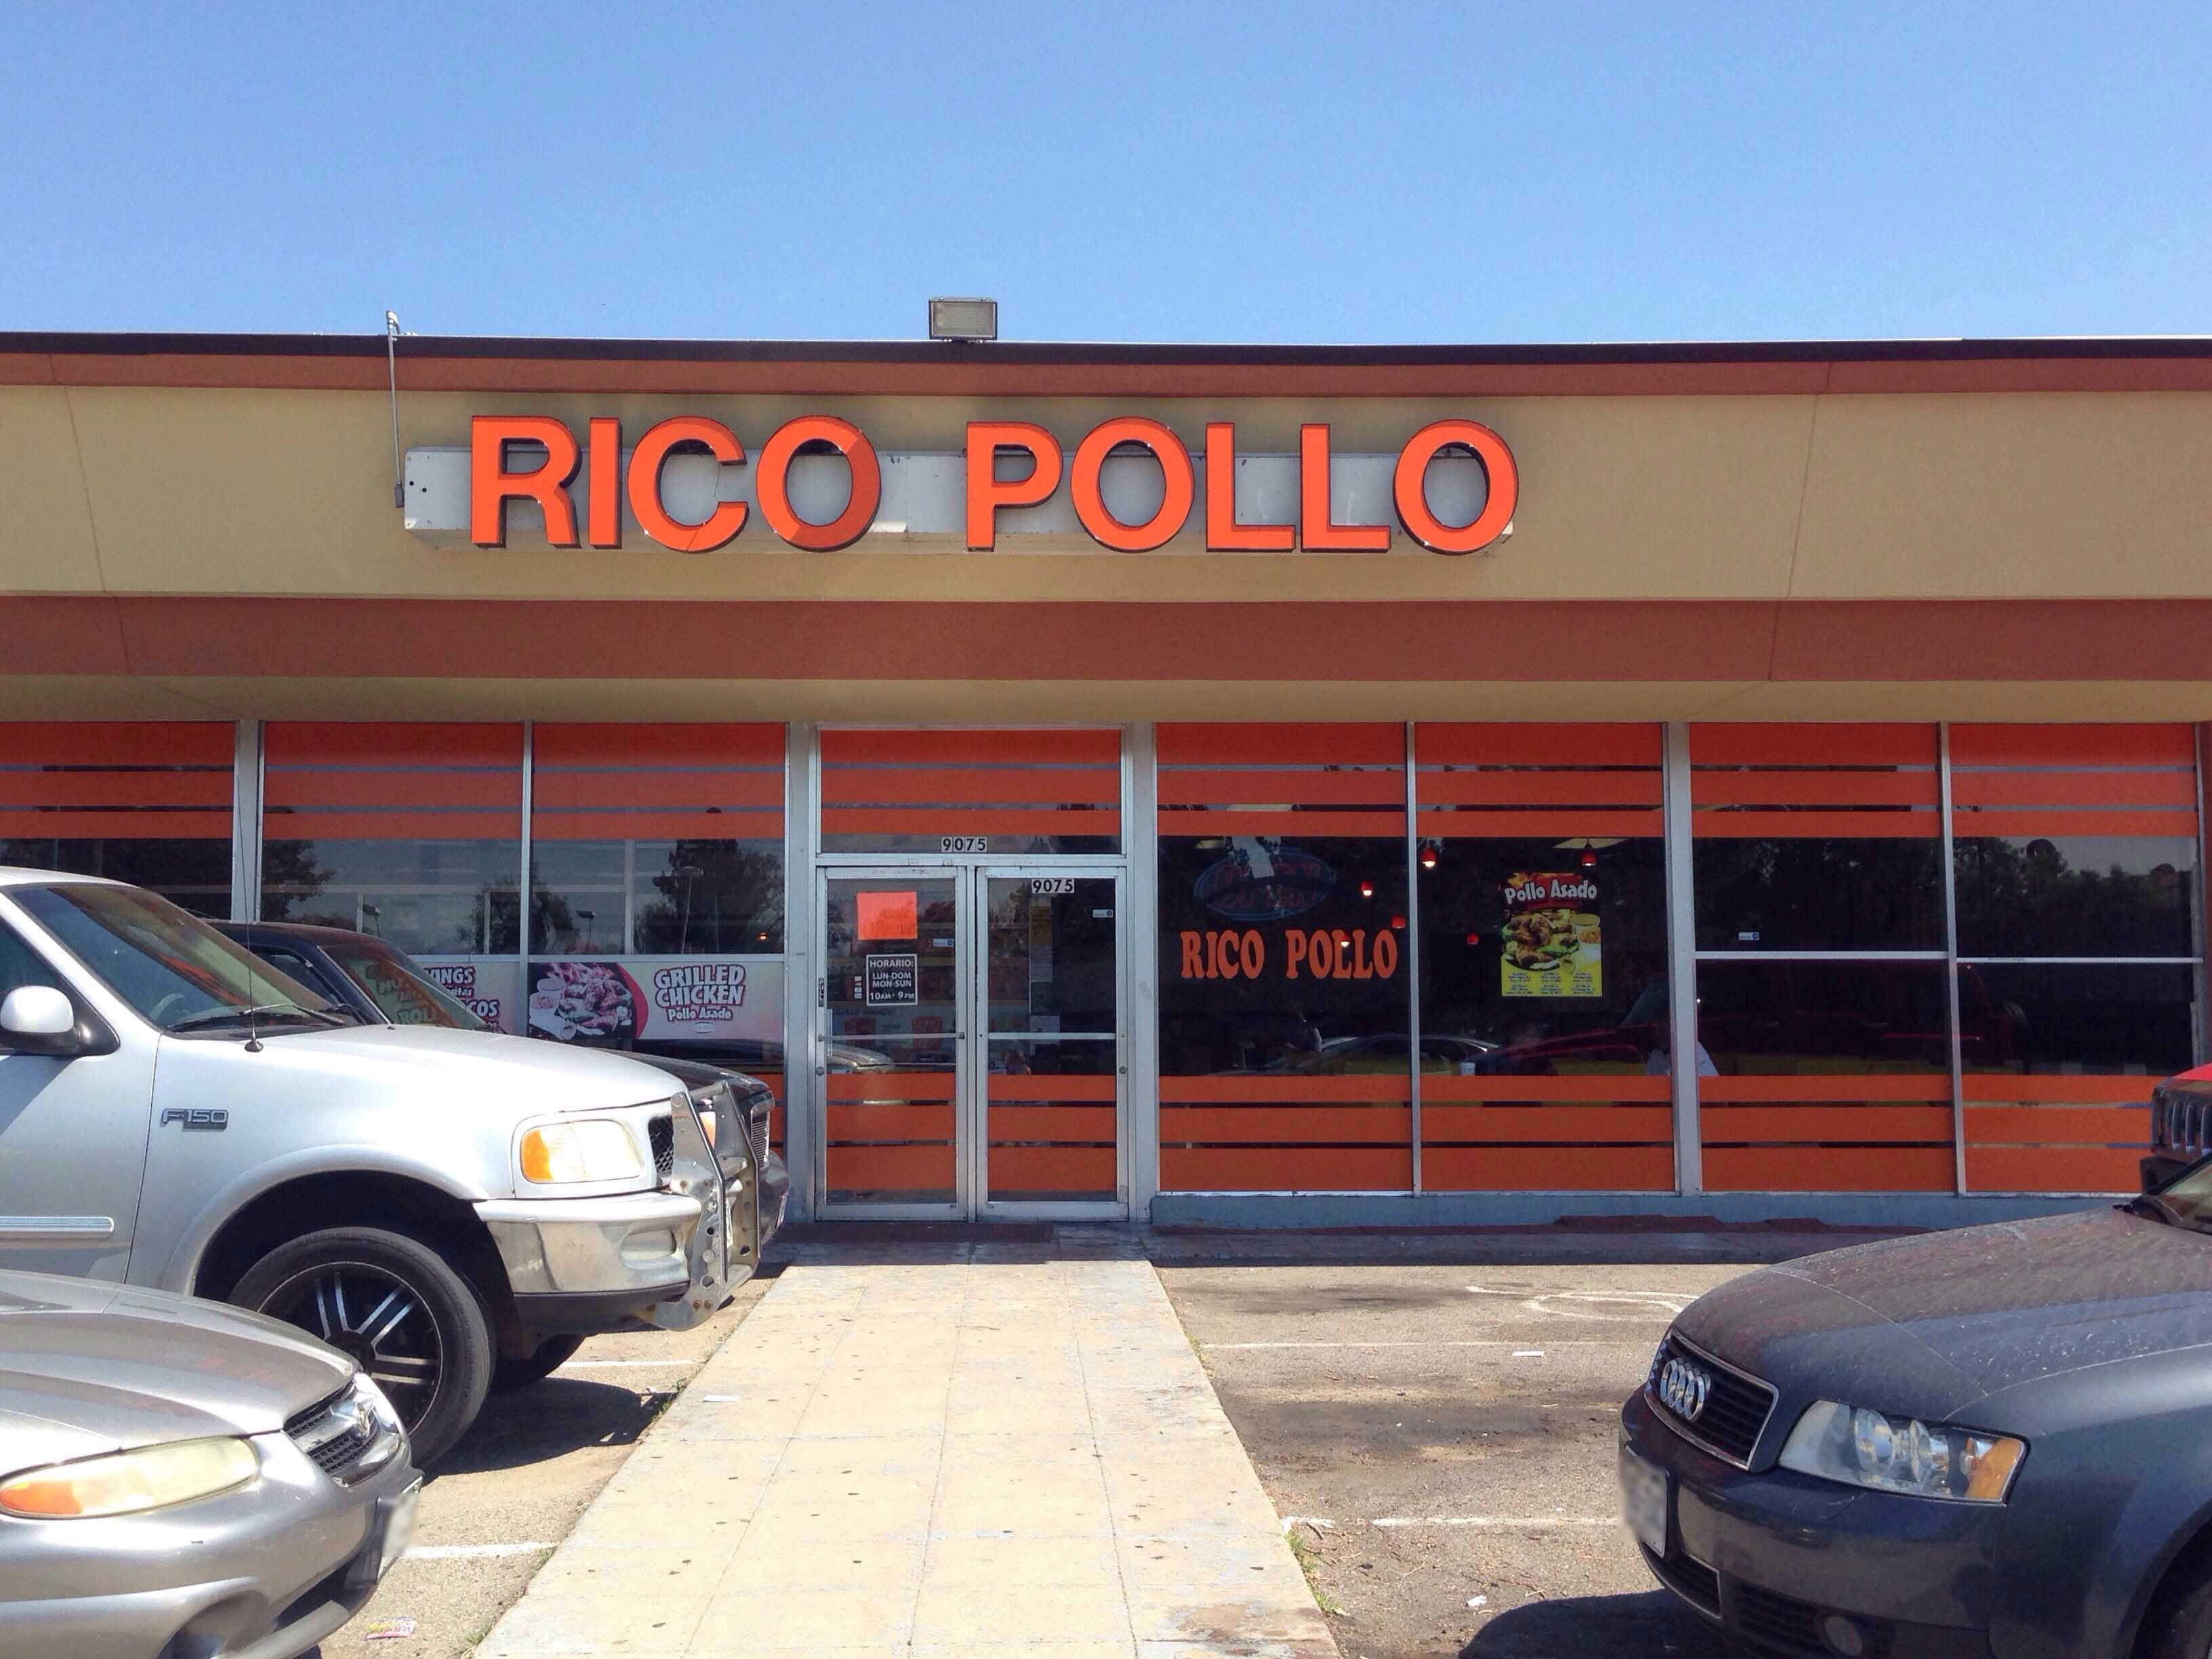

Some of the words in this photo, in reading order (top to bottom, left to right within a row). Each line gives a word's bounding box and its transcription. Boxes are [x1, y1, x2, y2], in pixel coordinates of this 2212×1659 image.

[471, 415, 882, 553] RICO
[966, 416, 1519, 556] POLLO
[943, 838, 987, 851] 9075
[1032, 879, 1073, 893] 9075
[1504, 882, 1546, 905] Pollo
[1550, 878, 1597, 899] Asado
[1180, 929, 1265, 979] RICO
[1285, 928, 1398, 979] POLLO
[869, 959, 915, 968] HORARIO:
[424, 967, 474, 984] INGS
[655, 964, 745, 989] GRILLED
[655, 985, 745, 1008] CHICKEN
[465, 1000, 499, 1017] COS
[668, 1007, 697, 1021] Pollo
[699, 1006, 733, 1020] Asado
